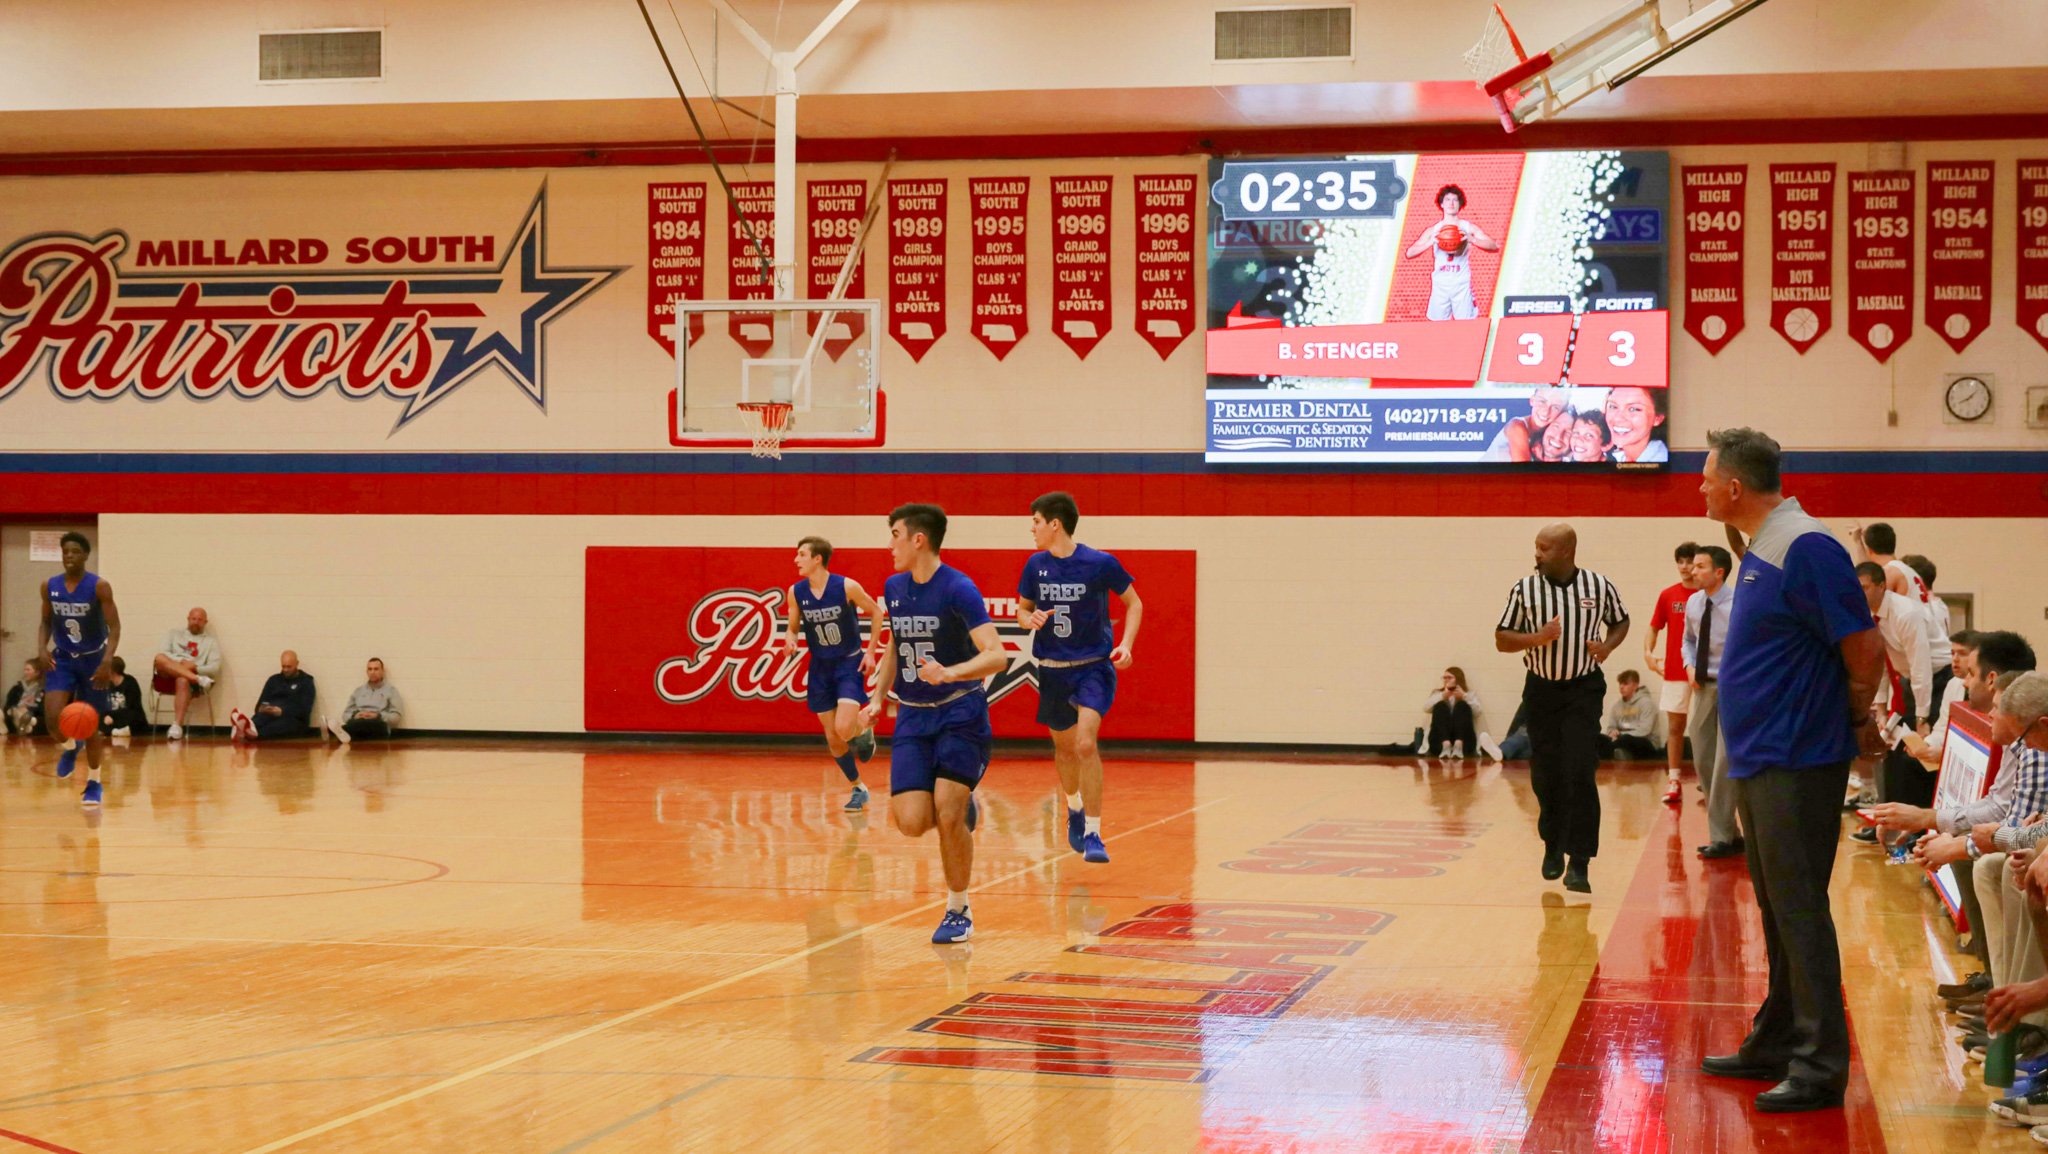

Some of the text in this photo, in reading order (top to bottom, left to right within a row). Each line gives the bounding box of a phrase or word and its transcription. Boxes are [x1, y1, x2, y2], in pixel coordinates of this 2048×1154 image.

[1686, 171, 1743, 186] MILLARD
[1774, 170, 1831, 184] MILLARD
[1931, 168, 1989, 182] MILLARD
[811, 185, 862, 198] MILLARD
[892, 183, 944, 196] MILLARD
[973, 182, 1026, 195] MILLARD
[1055, 180, 1108, 194] MILLARD
[1139, 179, 1192, 192] MILLARD
[1240, 171, 1377, 212] 02:35
[1853, 178, 1910, 192] MILLARD
[2034, 185, 2048, 197] HI
[653, 187, 703, 199] MILLARD
[732, 187, 774, 198] MILLAR
[1698, 189, 1731, 203] HIGH
[1786, 188, 1819, 202] HIGH
[1944, 185, 1977, 199] HIGH
[818, 199, 856, 212] SOUTH
[898, 197, 937, 211] SOUTH
[980, 197, 1019, 209] SOUTH
[1062, 195, 1101, 208] SOUTH
[1145, 193, 1185, 206] SOUTH
[1865, 195, 1898, 209] HIGH
[659, 202, 696, 213] SOUTH
[1141, 213, 1190, 234] 1996
[1687, 211, 1742, 232] 1940
[1777, 210, 1827, 231] 1951
[1932, 207, 1988, 229] 1954
[2022, 207, 2047, 227] 19
[653, 220, 701, 240] 1984
[812, 218, 862, 238] 1989
[892, 216, 943, 237] 1989
[974, 216, 1024, 236] 1995
[1057, 214, 1106, 235] 1996
[1854, 217, 1909, 238] 1953
[1219, 221, 1319, 242] PATRIO
[904, 243, 932, 254] GIRLS
[986, 242, 1013, 253] BOYS
[1064, 240, 1098, 252] GRAND
[1151, 239, 1178, 251] BOYS
[1700, 240, 1727, 251] STATE
[1787, 239, 1814, 250] STATE
[1945, 237, 1973, 248] STATE
[135, 235, 495, 267] MILLARD SOUTH
[661, 246, 693, 256] GRAND
[1139, 251, 1189, 263] CHAMPION
[1689, 251, 1739, 262] CHAMPIONS
[1776, 250, 1826, 261] CHAMPIONS
[1867, 247, 1895, 258] STATE
[1933, 248, 1984, 259] CHAMPIONS
[653, 257, 701, 268] CHAMPION
[893, 254, 943, 266] CHAMPION
[974, 254, 1024, 266] CHAMPION
[1056, 252, 1106, 264] CHAMPION
[1855, 259, 1906, 270] CHAMPIONS
[656, 275, 682, 286] CLASS
[895, 272, 922, 285] CLASS
[977, 273, 1005, 285] CLASS
[1059, 270, 1087, 282] CLASS
[1142, 269, 1170, 281] CLASS
[666, 293, 688, 303] ALL
[907, 291, 930, 302] ALL
[989, 293, 1011, 304] ALL
[1070, 288, 1093, 299] ALL
[1153, 288, 1177, 299] ALL
[1691, 288, 1737, 302] BASEBALL
[1772, 287, 1831, 302] BASKETBALL
[1934, 285, 1983, 300] BASEBALL
[2025, 285, 2048, 299] BASE
[895, 301, 940, 313] SPORTS
[1058, 299, 1104, 311] SPORTS
[1141, 299, 1187, 311] SPORTS
[1508, 300, 1565, 314] JERSEY
[1595, 297, 1654, 310] POINTS
[1857, 295, 1905, 310] BASEBALL
[0, 238, 433, 393] Patriots
[976, 304, 1023, 315] SPORTS
[1278, 342, 1399, 359] B. STENGER
[1517, 332, 1544, 365] 3
[1608, 330, 1636, 367] 3
[1213, 401, 1372, 418] PREMIER DENTAL
[1384, 408, 1507, 424] (402)718-8741
[1213, 424, 1251, 436] FAMILY,
[1252, 423, 1311, 435] COSMETIC
[1321, 423, 1372, 435] SEDATION
[1295, 436, 1368, 448] DENTISTRY
[1384, 432, 1484, 441] PREMIERSMILE.COM
[1039, 583, 1086, 601] PREP
[52, 601, 91, 617] PREP
[803, 606, 842, 622] PREP
[892, 616, 940, 637] PREP
[1053, 605, 1072, 638] 5
[65, 619, 82, 644] 3
[815, 622, 841, 646] 10
[899, 642, 935, 682] 35
[847, 902, 1398, 1084] MILLARD
